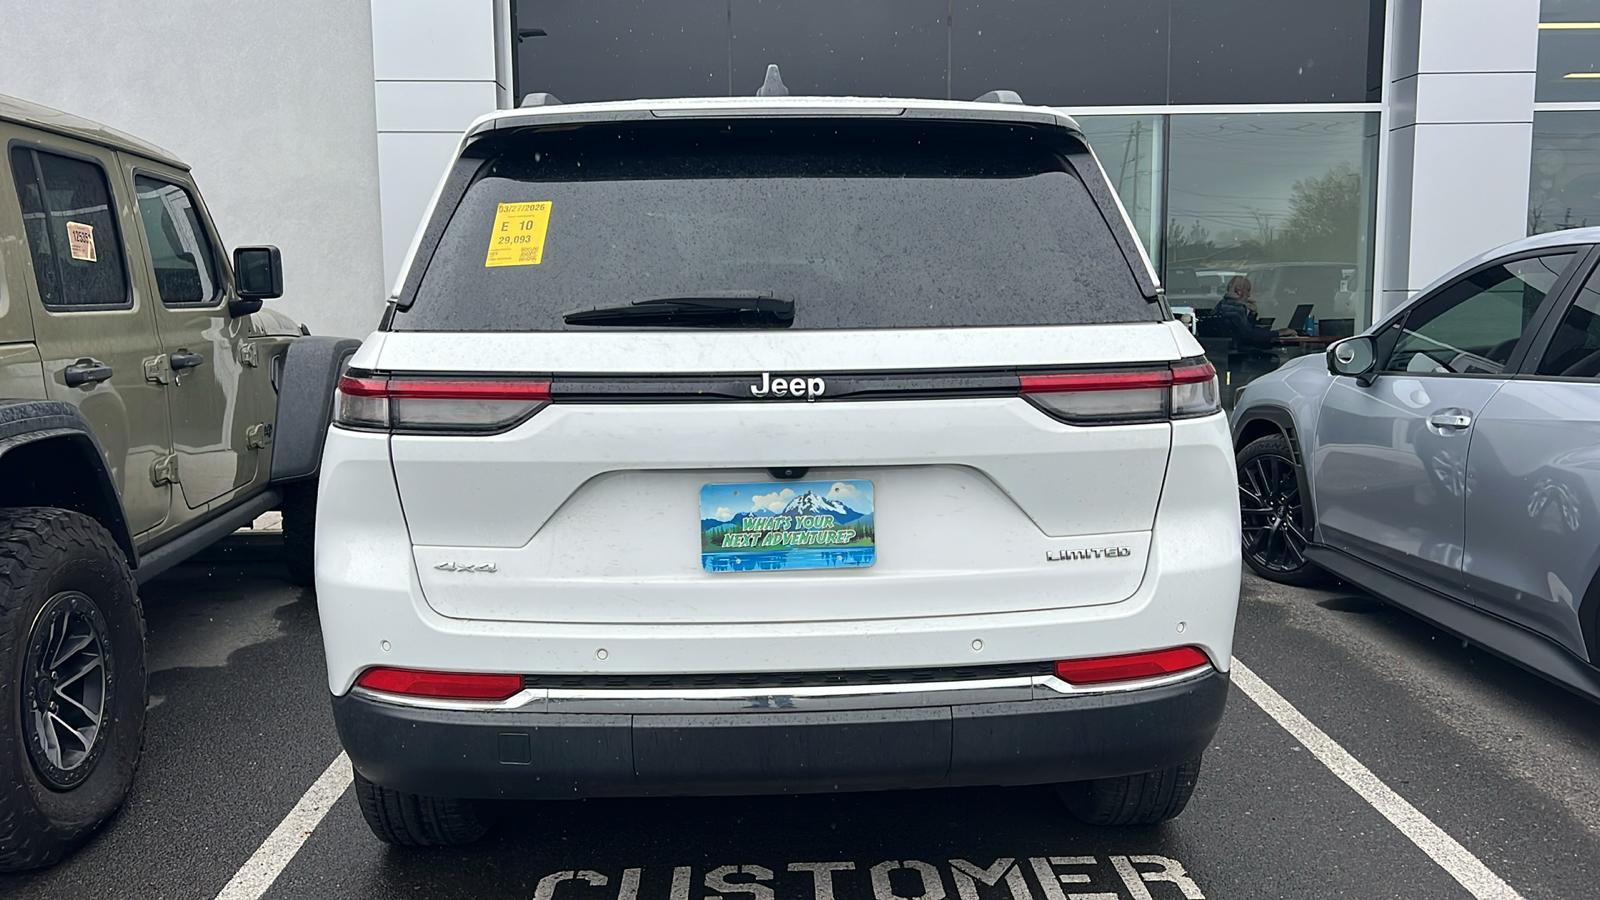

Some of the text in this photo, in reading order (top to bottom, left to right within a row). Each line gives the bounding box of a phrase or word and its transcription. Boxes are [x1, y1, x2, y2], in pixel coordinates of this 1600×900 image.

[498, 203, 546, 213] 03/27/2026
[501, 220, 534, 232] E 10
[498, 235, 531, 245] 29,093
[750, 372, 826, 402] Jeep
[742, 514, 835, 532] WHAT'S YOUR
[721, 529, 857, 548] NEXT ADVENTURE?
[1046, 546, 1131, 561] LIMITED
[534, 854, 1207, 900] CUSTOMER
